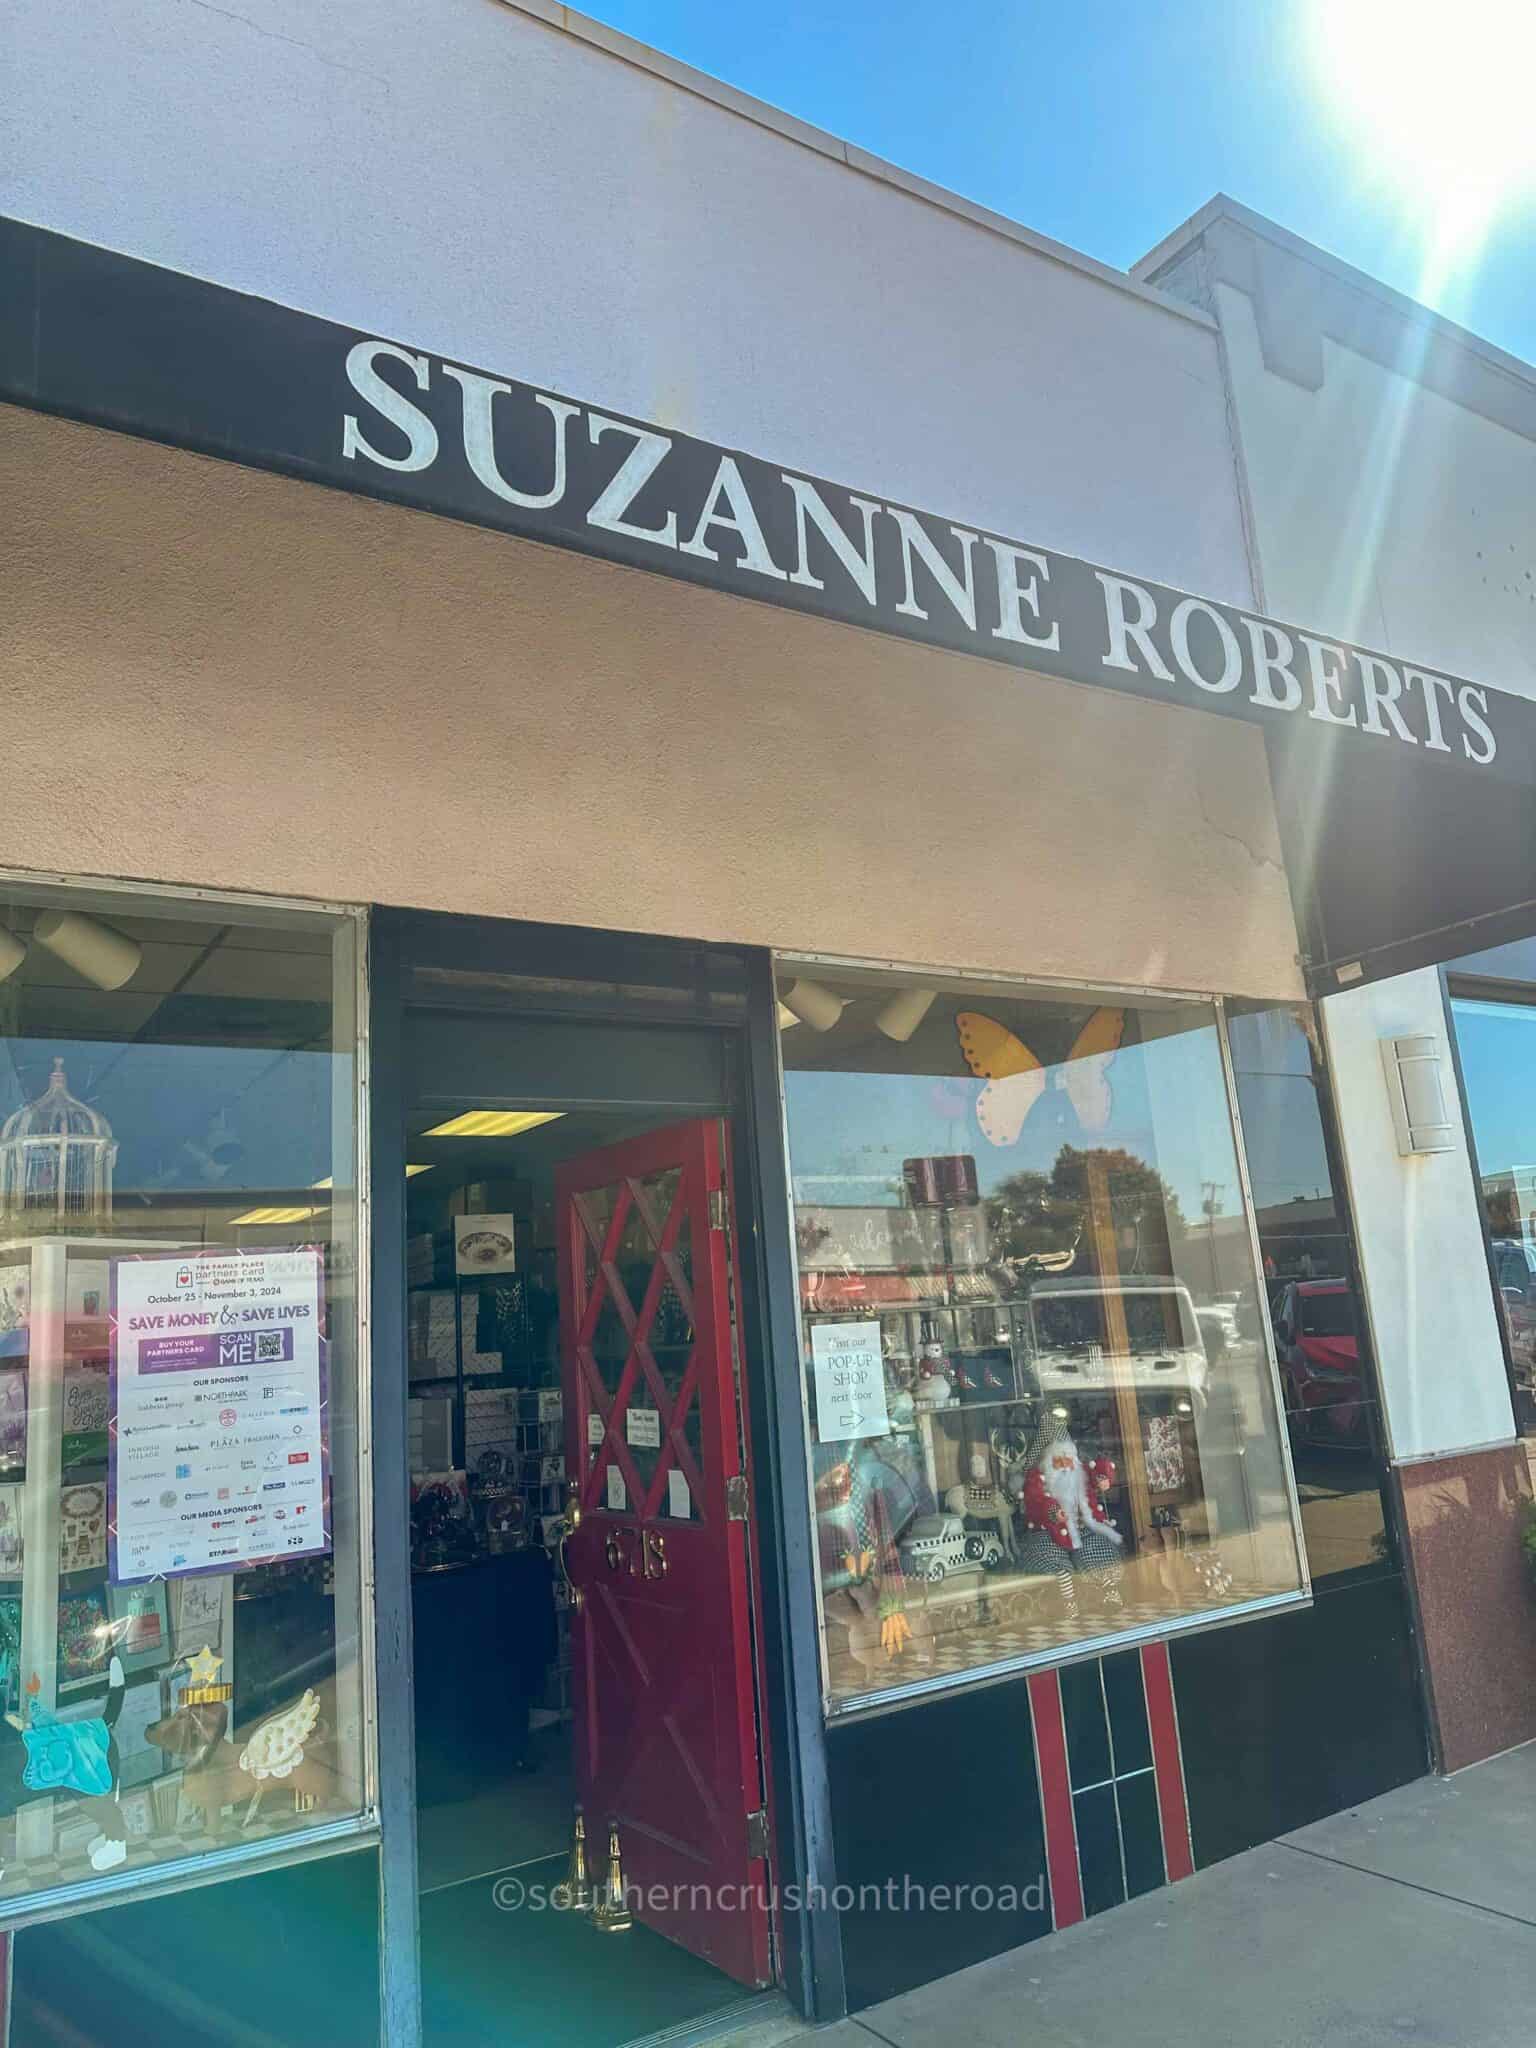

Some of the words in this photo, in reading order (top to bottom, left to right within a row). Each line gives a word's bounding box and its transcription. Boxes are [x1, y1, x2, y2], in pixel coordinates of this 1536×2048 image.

[343, 341, 1060, 651] SUZANNE
[1095, 572, 1496, 763] ROBERTS
[195, 1270, 239, 1280] partners
[241, 1267, 264, 1277] card
[148, 1294, 181, 1304] October
[184, 1293, 196, 1301] 25
[204, 1290, 246, 1300] November
[259, 1287, 281, 1297] 2024
[128, 1316, 165, 1330] SAVE
[167, 1312, 218, 1327] MONEY
[241, 1308, 275, 1321] SAVE
[278, 1304, 311, 1319] LIVES
[219, 1332, 252, 1345] SCAN
[147, 1348, 184, 1357] PARTNERS
[184, 1346, 205, 1354] CARD
[219, 1343, 252, 1366] ME
[828, 1353, 873, 1369] POP-UP
[210, 1375, 249, 1385] SPONSORS
[833, 1370, 868, 1386] SHOP
[832, 1393, 849, 1402] next
[198, 1510, 222, 1518] MEDIA
[224, 1503, 262, 1515] SPONSORS
